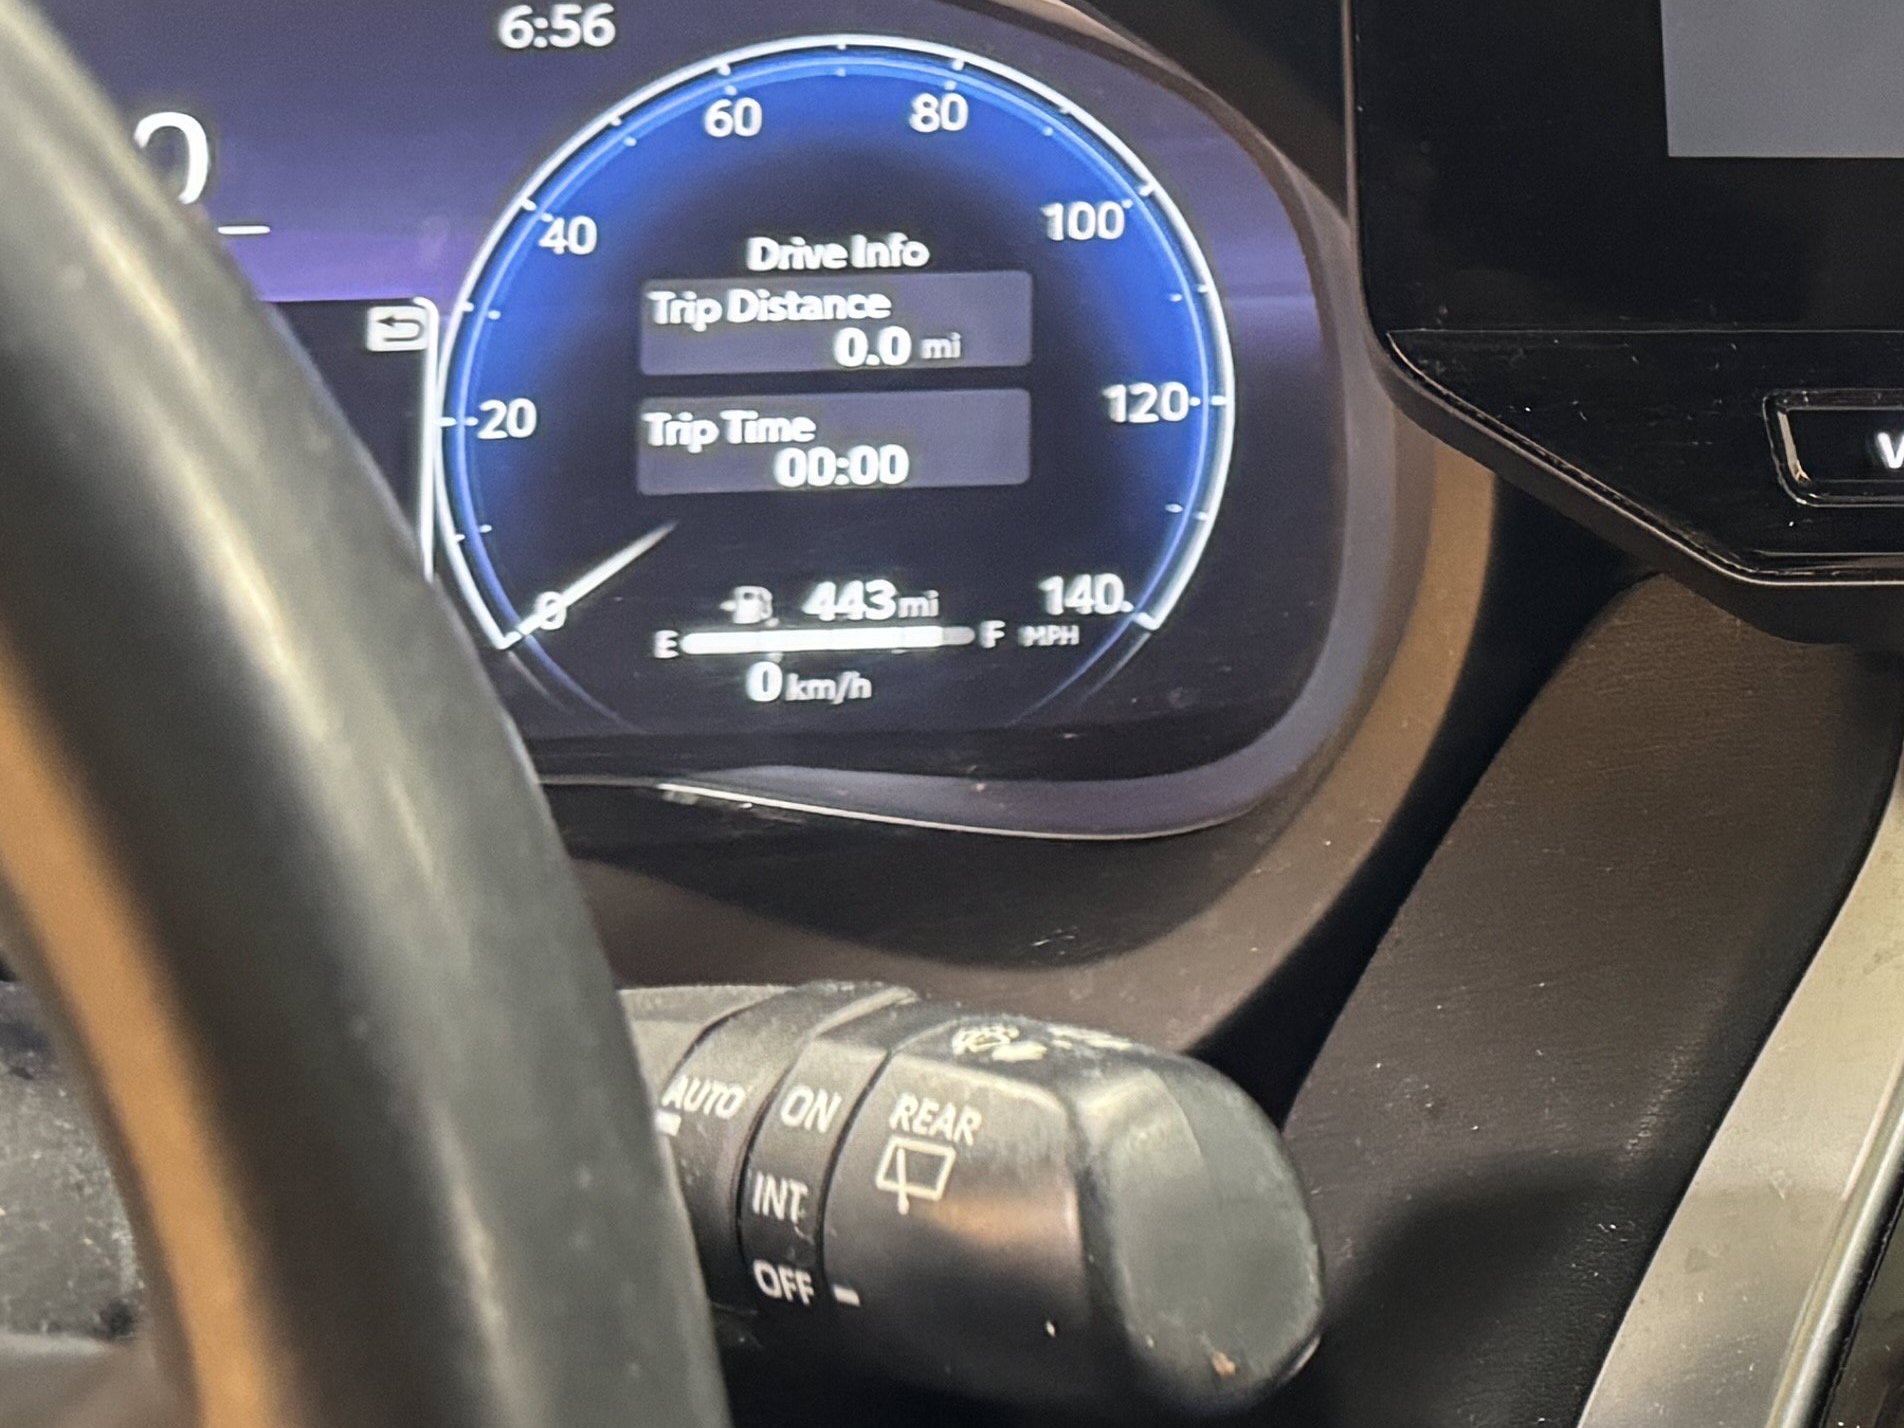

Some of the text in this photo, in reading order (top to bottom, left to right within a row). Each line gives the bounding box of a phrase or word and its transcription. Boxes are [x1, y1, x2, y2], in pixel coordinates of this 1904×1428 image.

[499, 3, 615, 48] 6:56
[705, 97, 762, 137] 60
[910, 93, 968, 132] 80
[538, 216, 597, 255] 40
[1042, 201, 1124, 241] 100
[747, 233, 929, 270] Drive Info
[648, 289, 892, 331] Trip Distance
[834, 326, 960, 366] 0.0 mi
[478, 398, 537, 439] 20
[1104, 382, 1188, 423] 120
[643, 410, 816, 453] Trip Time
[773, 444, 910, 488] 00:00
[1040, 573, 1122, 615] 140
[655, 630, 678, 658] E
[981, 621, 1005, 647] F
[1021, 625, 1079, 646] MPH
[661, 1075, 746, 1119] AUTO
[781, 1086, 842, 1133] ON
[889, 1092, 982, 1146] REAR
[753, 1171, 808, 1223] INT
[753, 1259, 815, 1306] OFF
